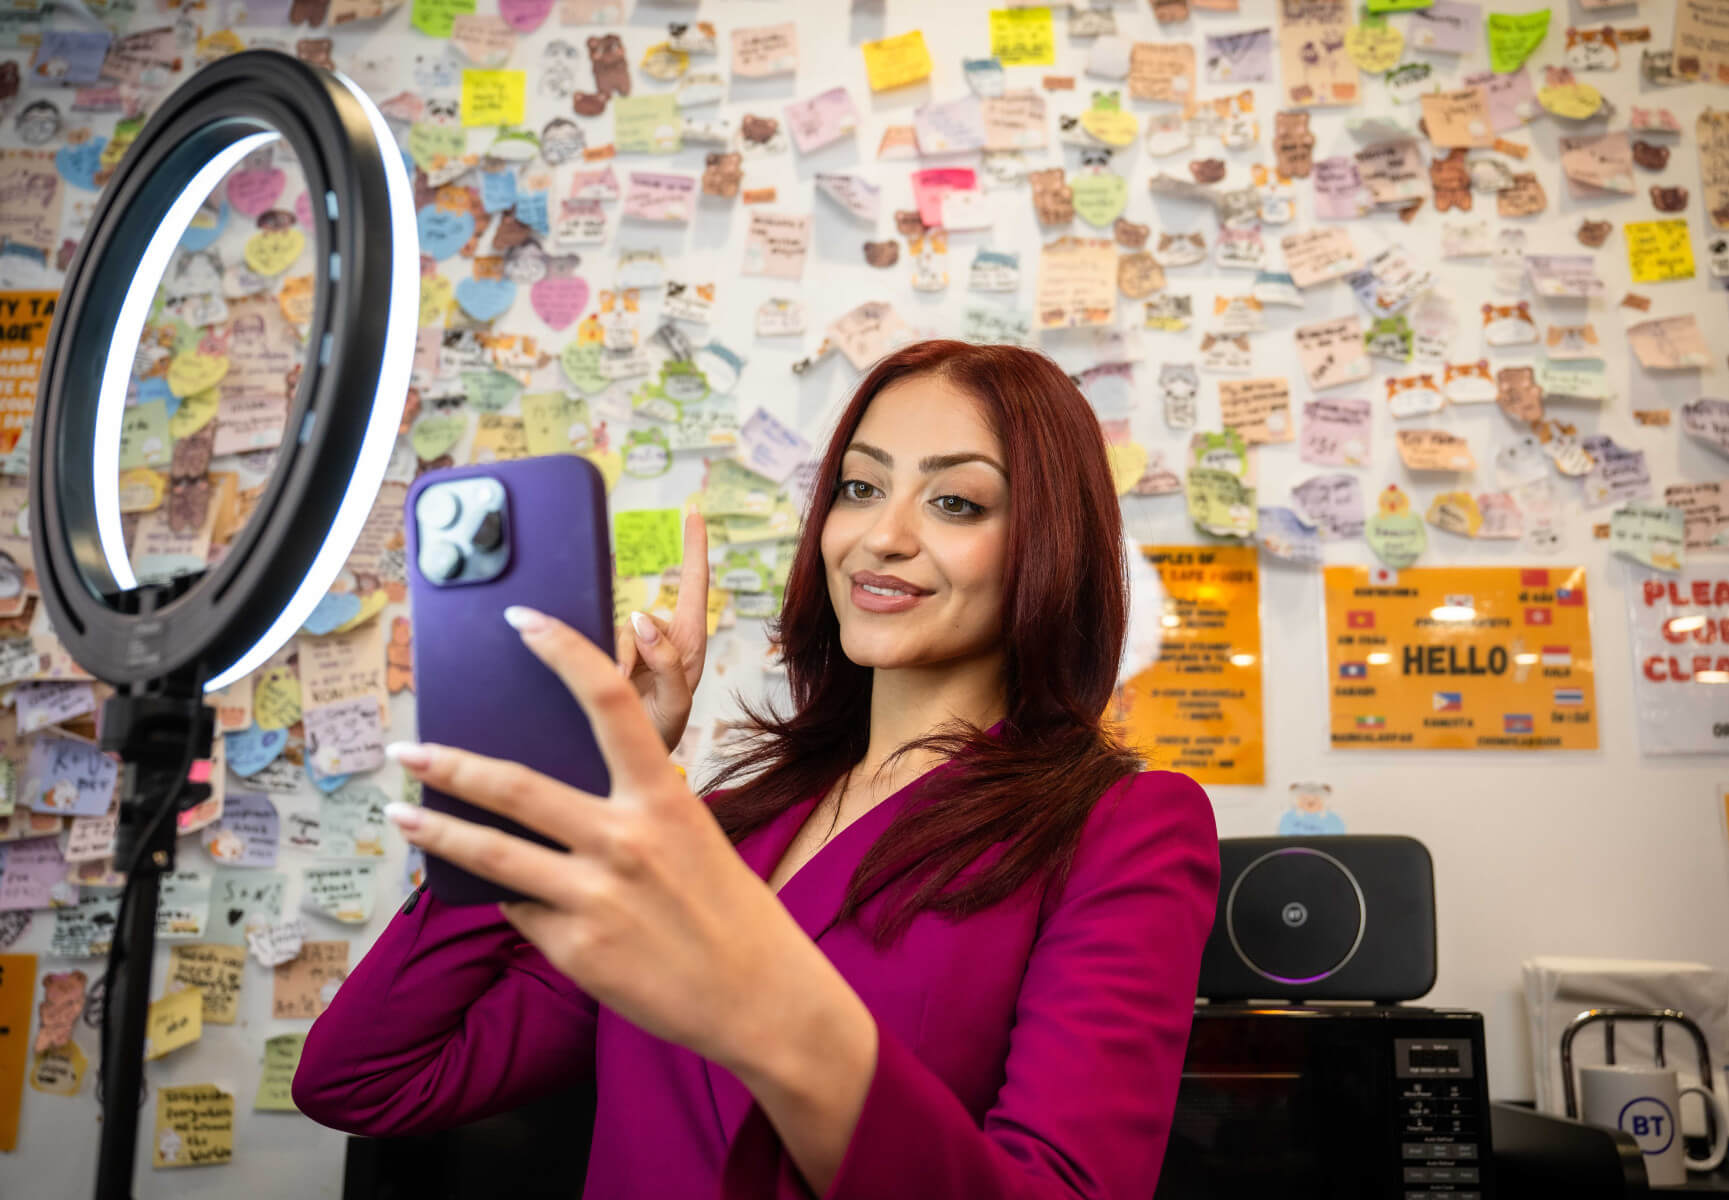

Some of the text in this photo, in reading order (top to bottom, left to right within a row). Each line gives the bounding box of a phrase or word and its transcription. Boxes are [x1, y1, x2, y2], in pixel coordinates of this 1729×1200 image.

[30, 298, 56, 317] TA
[1403, 646, 1508, 676] HELLO
[1633, 1115, 1664, 1136] BT
